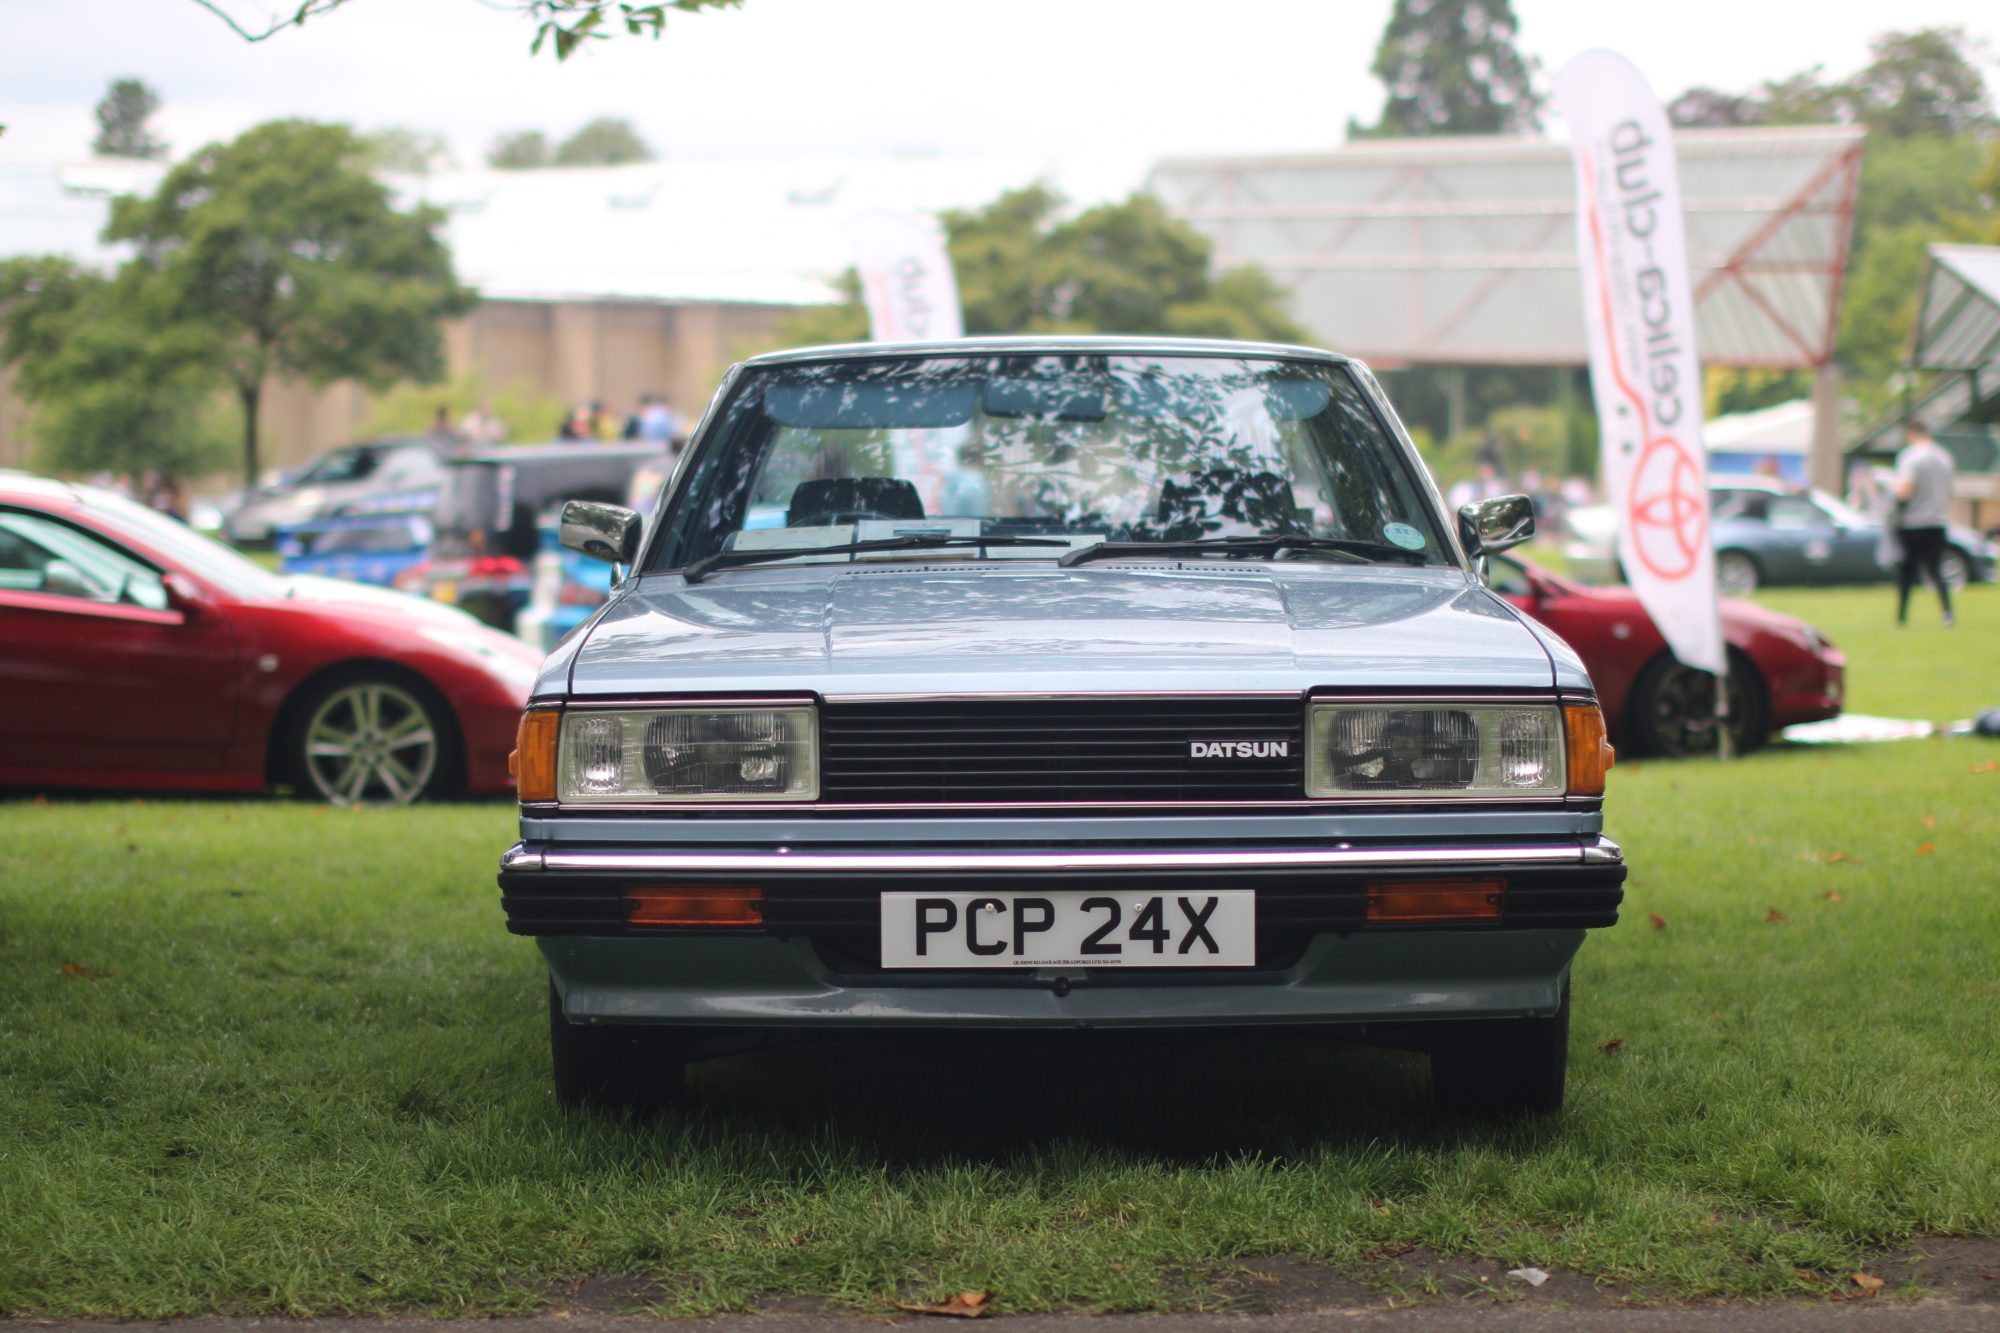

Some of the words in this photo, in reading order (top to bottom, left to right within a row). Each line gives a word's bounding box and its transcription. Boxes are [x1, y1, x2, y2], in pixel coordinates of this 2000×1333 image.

[1190, 741, 1288, 758] DATSUN
[915, 898, 1055, 956] PCP
[1080, 896, 1220, 955] 24X
